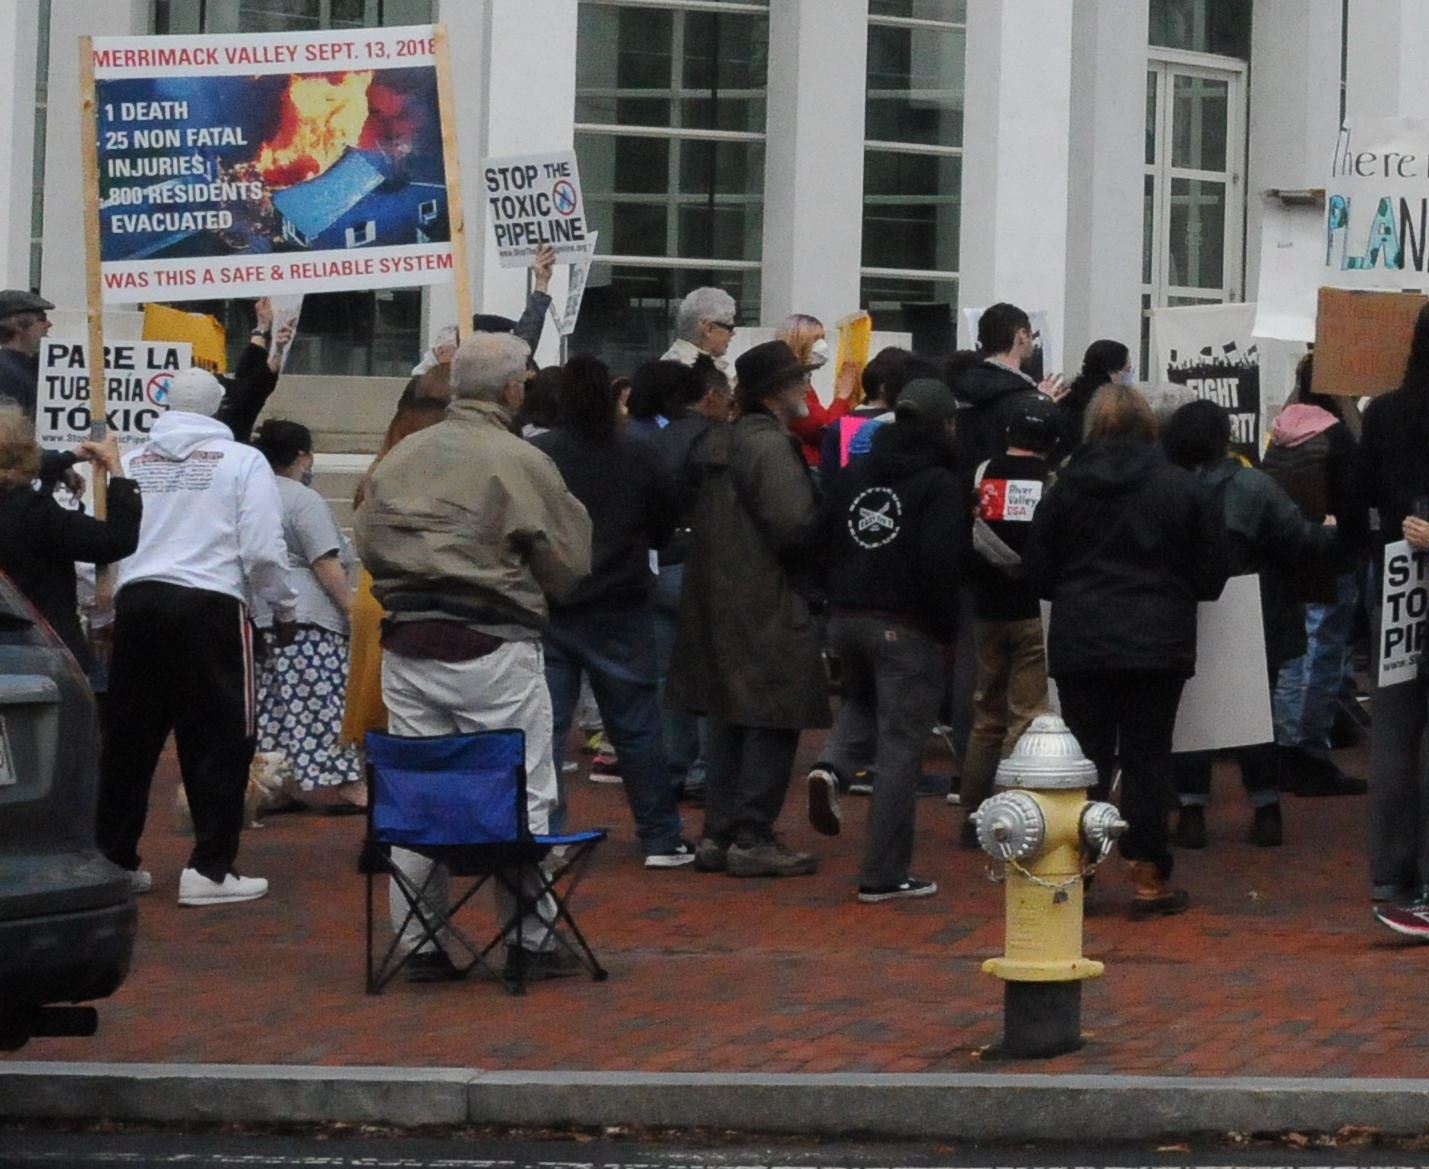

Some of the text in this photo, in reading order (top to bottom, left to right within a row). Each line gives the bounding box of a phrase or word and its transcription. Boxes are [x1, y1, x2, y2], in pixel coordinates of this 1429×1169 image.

[93, 37, 436, 69] MERRIMACK VALLEY SEPT. 13, 2018
[104, 101, 188, 122] 1 DEATH
[106, 127, 248, 149] 25 NON FATAL
[108, 154, 204, 178] INJURIES
[484, 161, 571, 193] STOP THE
[110, 182, 263, 205] 800 RESIDENTS
[489, 192, 552, 221] TOXIC
[111, 210, 233, 234] EVACUATED
[494, 217, 585, 247] PIPELINE
[105, 253, 453, 290] WAS THIS A SAFE & RELIABLE SYSTEM
[147, 347, 180, 371] LA
[45, 373, 144, 402] TUBRÍA
[1185, 378, 1240, 408] FIGHT
[1008, 495, 1037, 508] Valley
